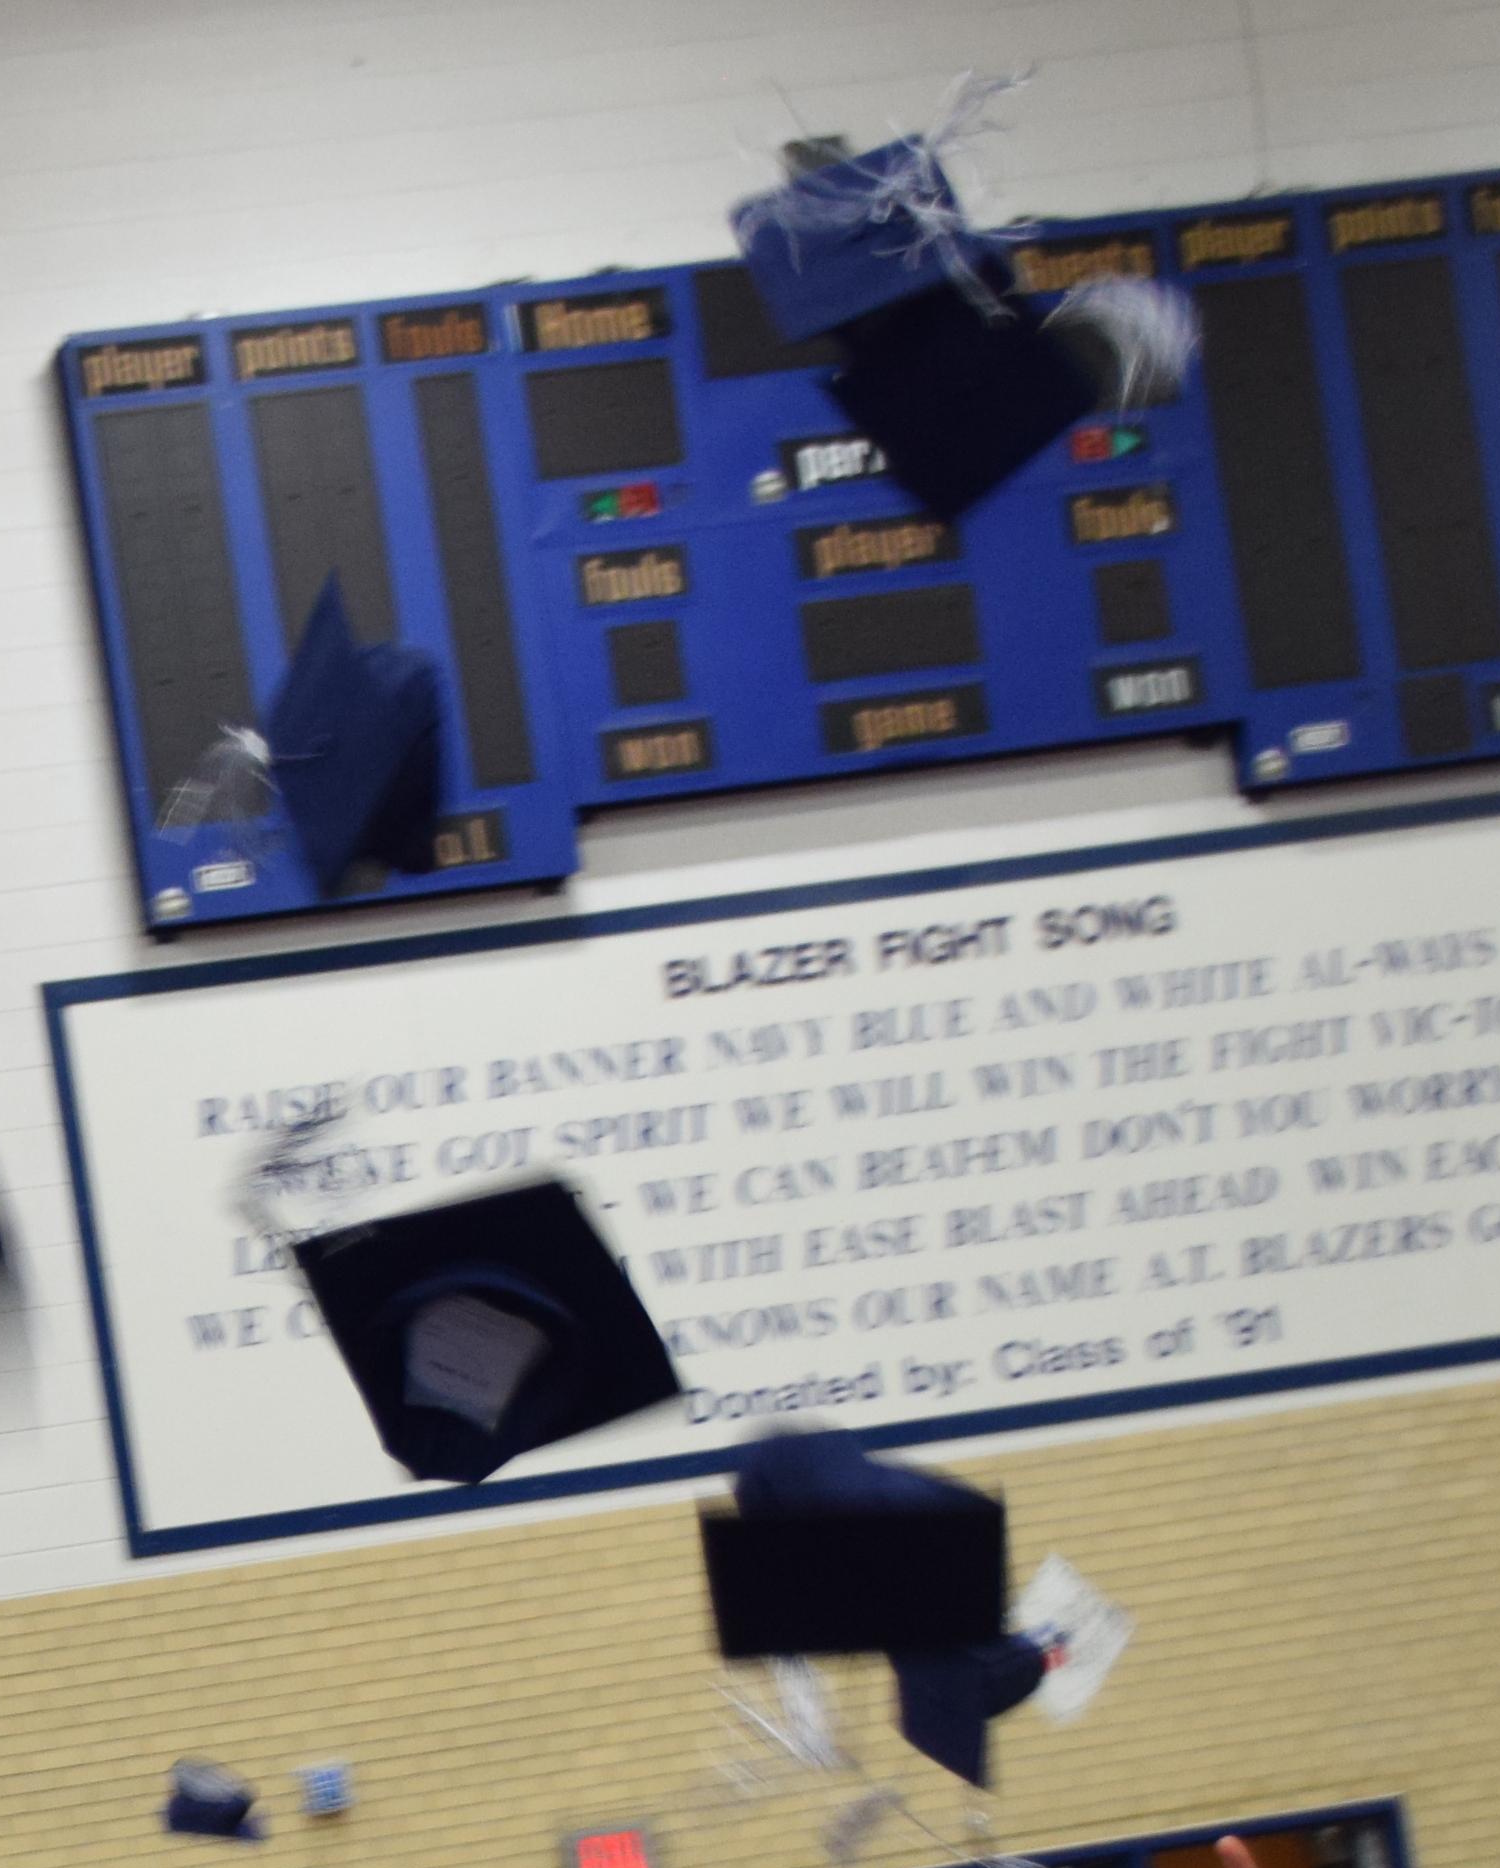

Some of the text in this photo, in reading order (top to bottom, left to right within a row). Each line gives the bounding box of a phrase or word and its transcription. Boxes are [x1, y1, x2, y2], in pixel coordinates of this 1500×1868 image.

[664, 895, 1177, 1000] BLAZER FIGHT SONG
[197, 1081, 346, 1138] RAISE
[364, 1066, 468, 1114] OUR
[486, 1036, 685, 1099] BANNER
[706, 1016, 833, 1070] NAVY
[851, 997, 975, 1051] BLUE
[990, 982, 1097, 1033] AND
[1113, 956, 1275, 1010] WHITE
[436, 1126, 539, 1176] GOT
[555, 1102, 717, 1159] SPIRIT
[733, 1089, 814, 1132] WE
[829, 1071, 958, 1119] WILL
[971, 1053, 1076, 1098] WIN
[1090, 1037, 1192, 1089] THE
[1209, 1015, 1354, 1072] FIGHT
[639, 1172, 720, 1216] WE
[735, 1156, 840, 1205] CAN
[1082, 1100, 1220, 1159] DON'T
[1233, 1087, 1330, 1138] YOU
[651, 1233, 784, 1284] WITH
[803, 1214, 925, 1270] EASE
[945, 1190, 1094, 1248] BLAST
[1110, 1166, 1280, 1225] AHEAD
[1308, 1147, 1409, 1194] WIN
[187, 1305, 268, 1350] WE
[663, 1297, 839, 1357] KNOWS
[851, 1281, 955, 1330] OUR
[977, 1256, 1121, 1314] NAME
[1240, 1210, 1453, 1277] BLAZERS
[684, 1361, 884, 1424] Donated
[993, 1336, 1127, 1381] Class
[1145, 1316, 1196, 1359] of
